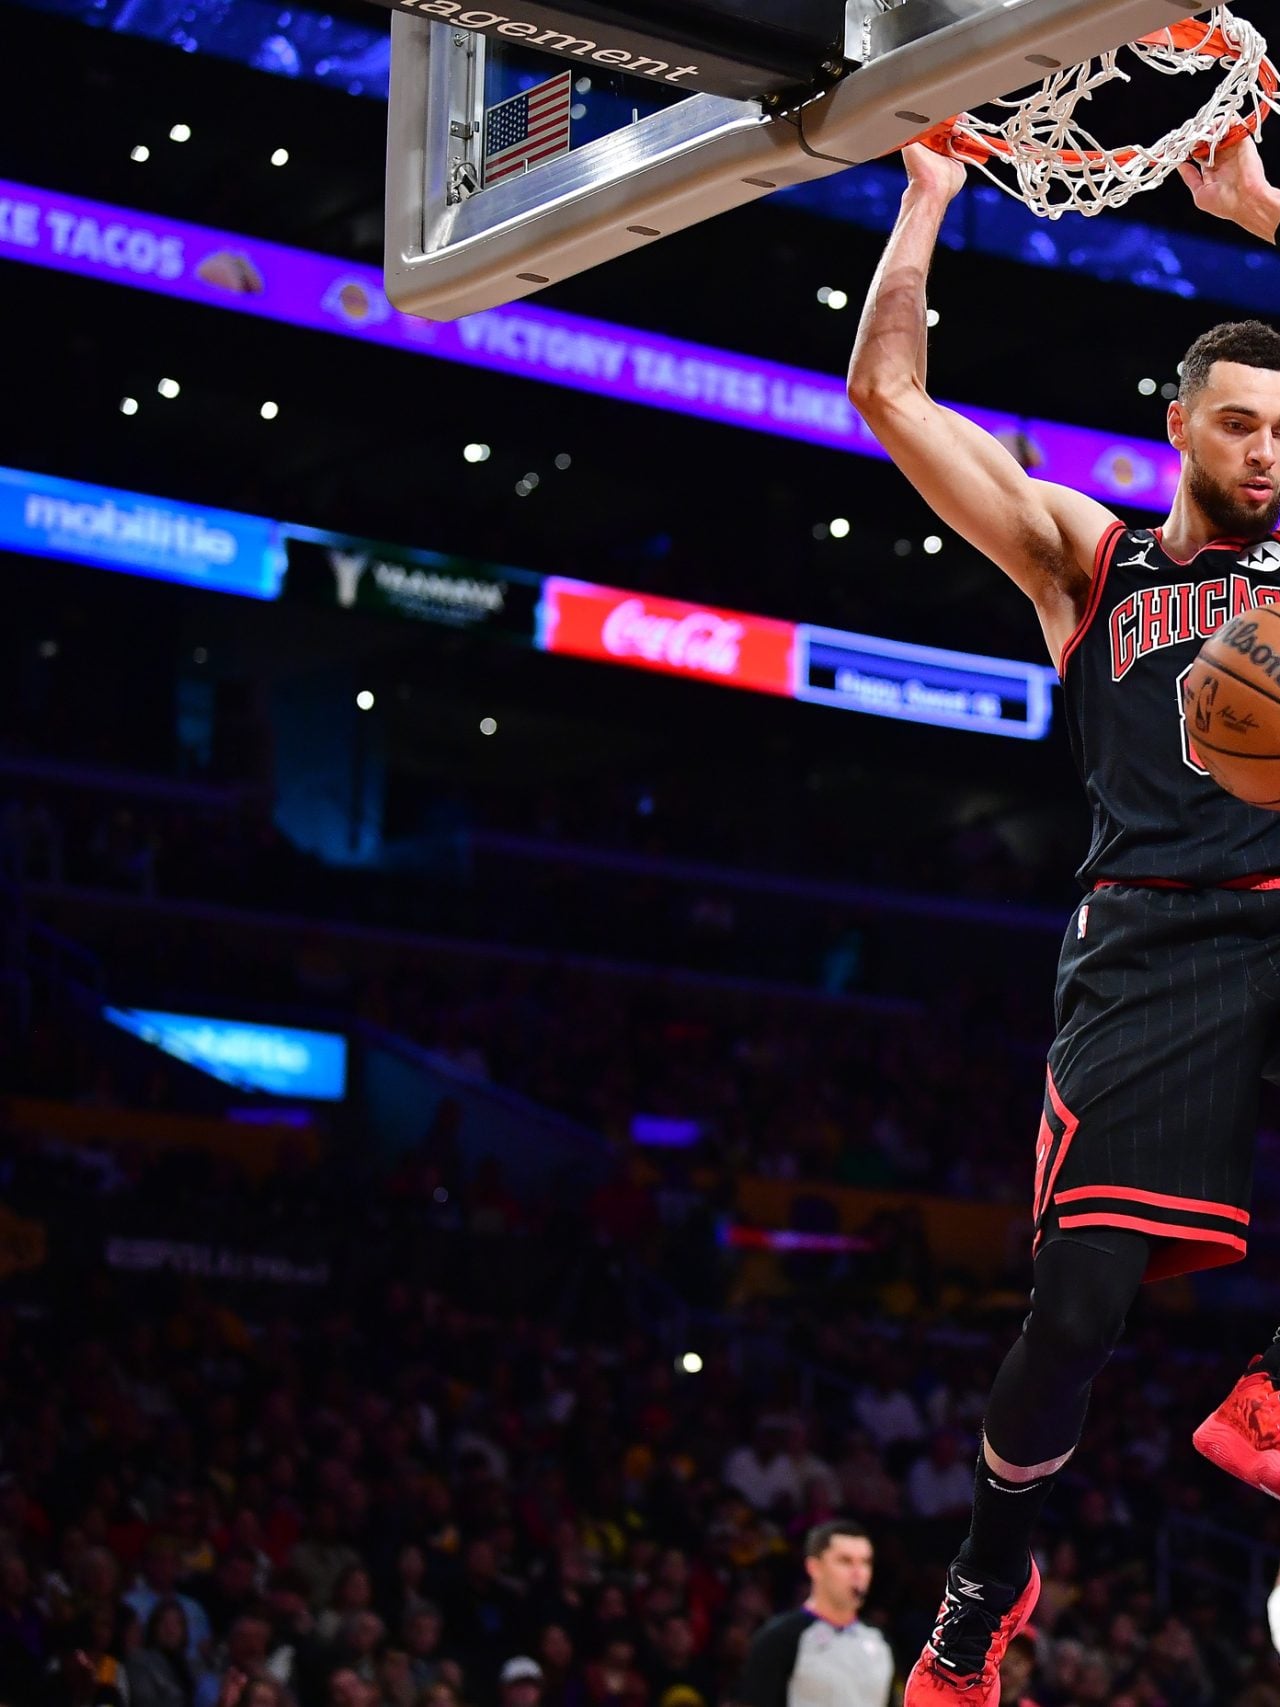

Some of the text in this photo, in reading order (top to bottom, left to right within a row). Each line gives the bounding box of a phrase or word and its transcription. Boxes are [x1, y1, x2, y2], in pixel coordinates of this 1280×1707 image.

[46, 207, 186, 281] TACOS
[457, 312, 850, 435] VICTORY TASTES LIKE
